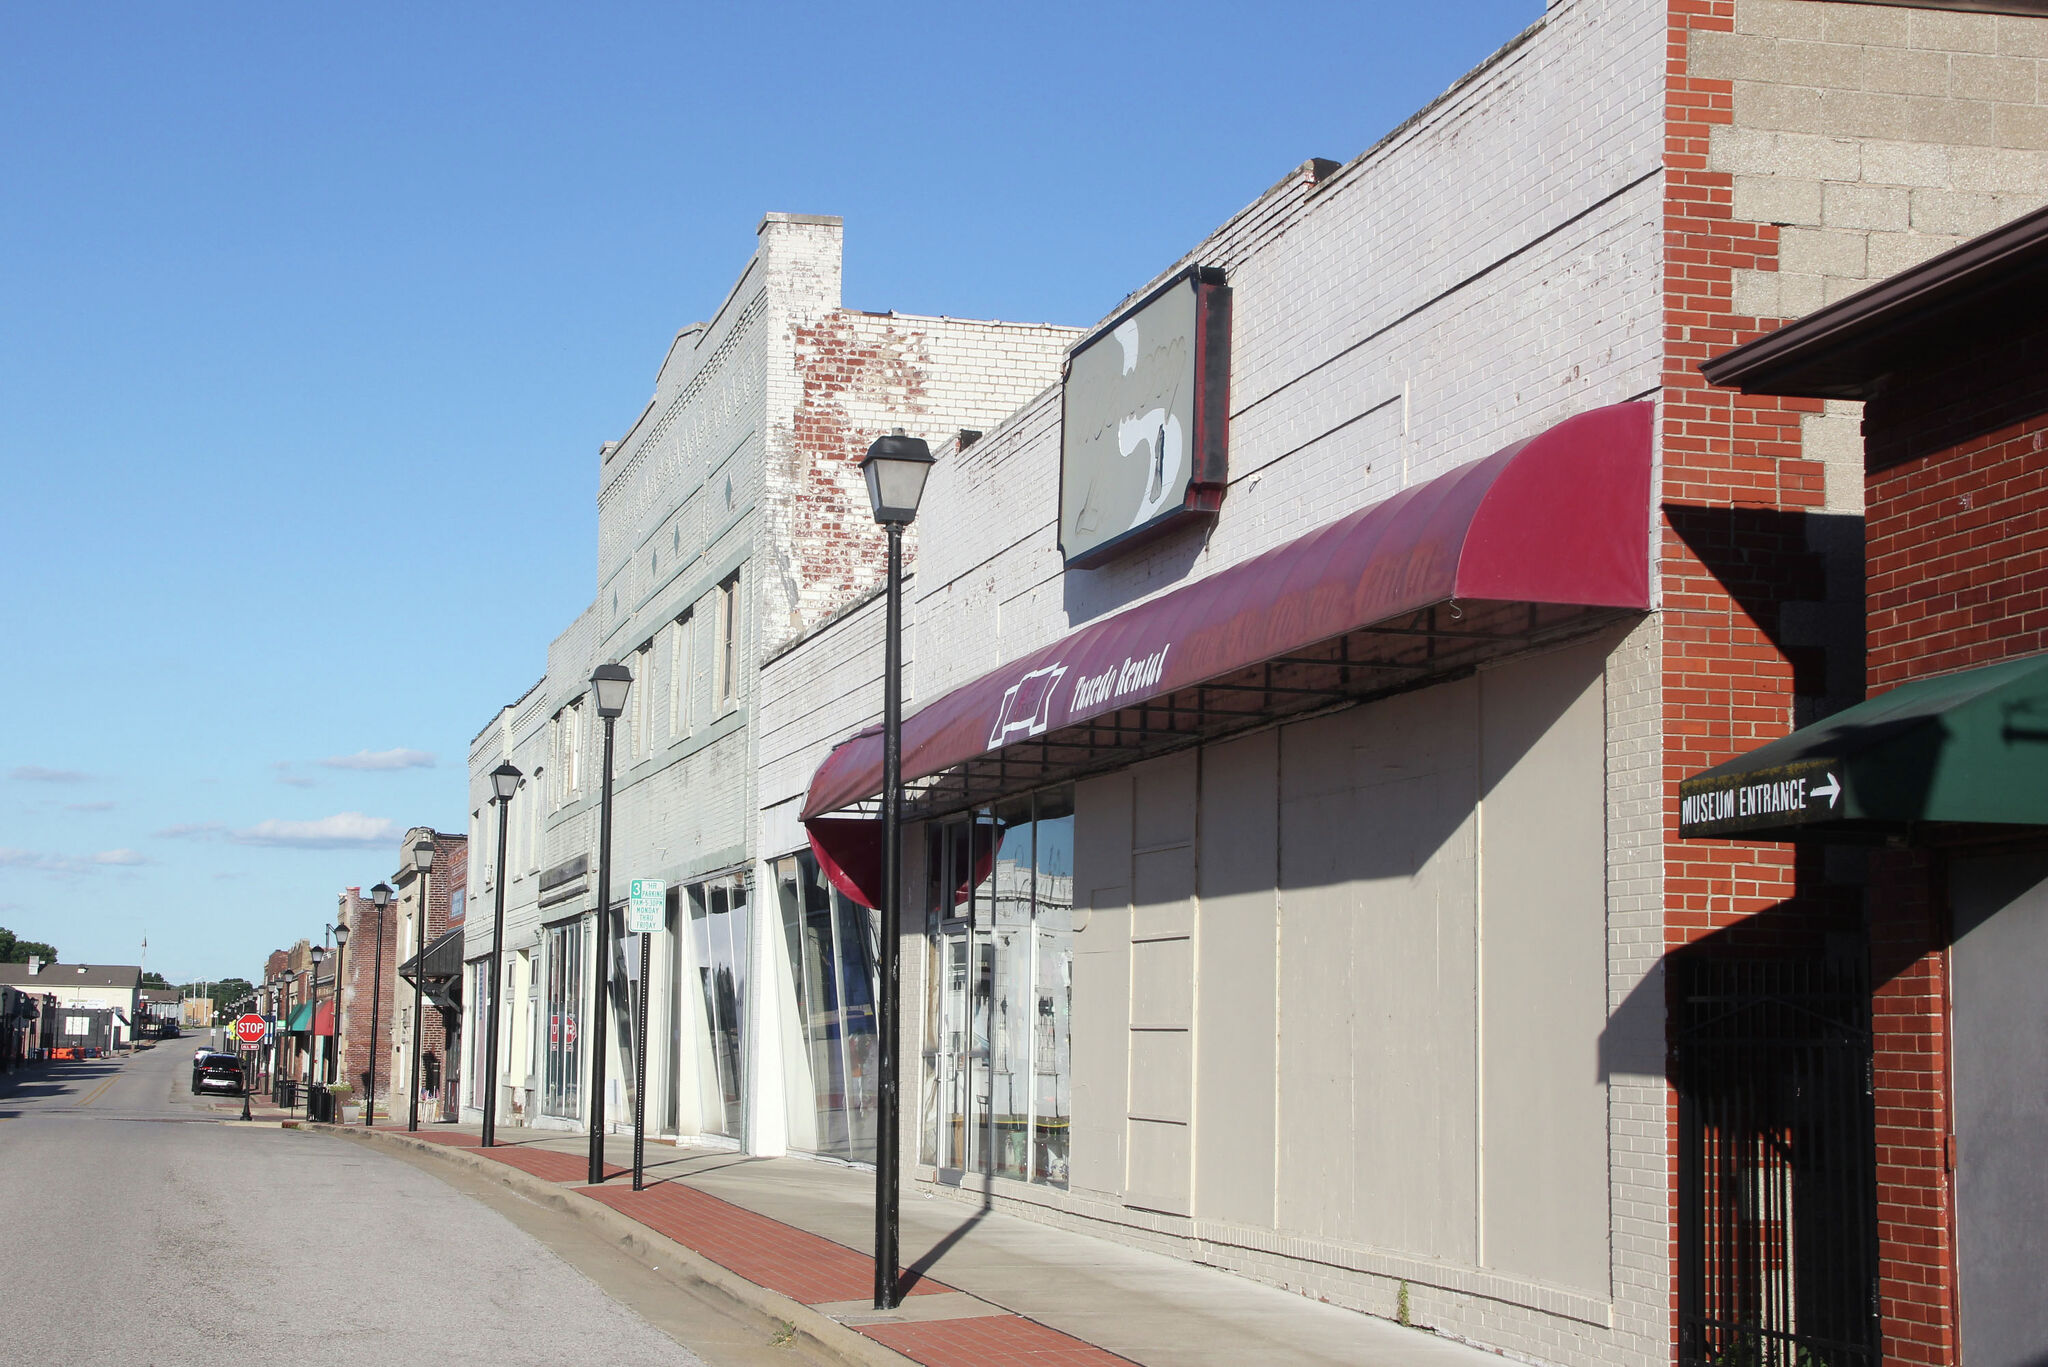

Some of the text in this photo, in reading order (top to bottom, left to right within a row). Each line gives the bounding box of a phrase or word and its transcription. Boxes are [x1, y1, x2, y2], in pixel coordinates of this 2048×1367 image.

[1114, 643, 1170, 696] Rental
[1682, 778, 1806, 824] MUSEUM ENTRANCE
[633, 883, 641, 895] 3
[238, 1022, 264, 1034] STOP
